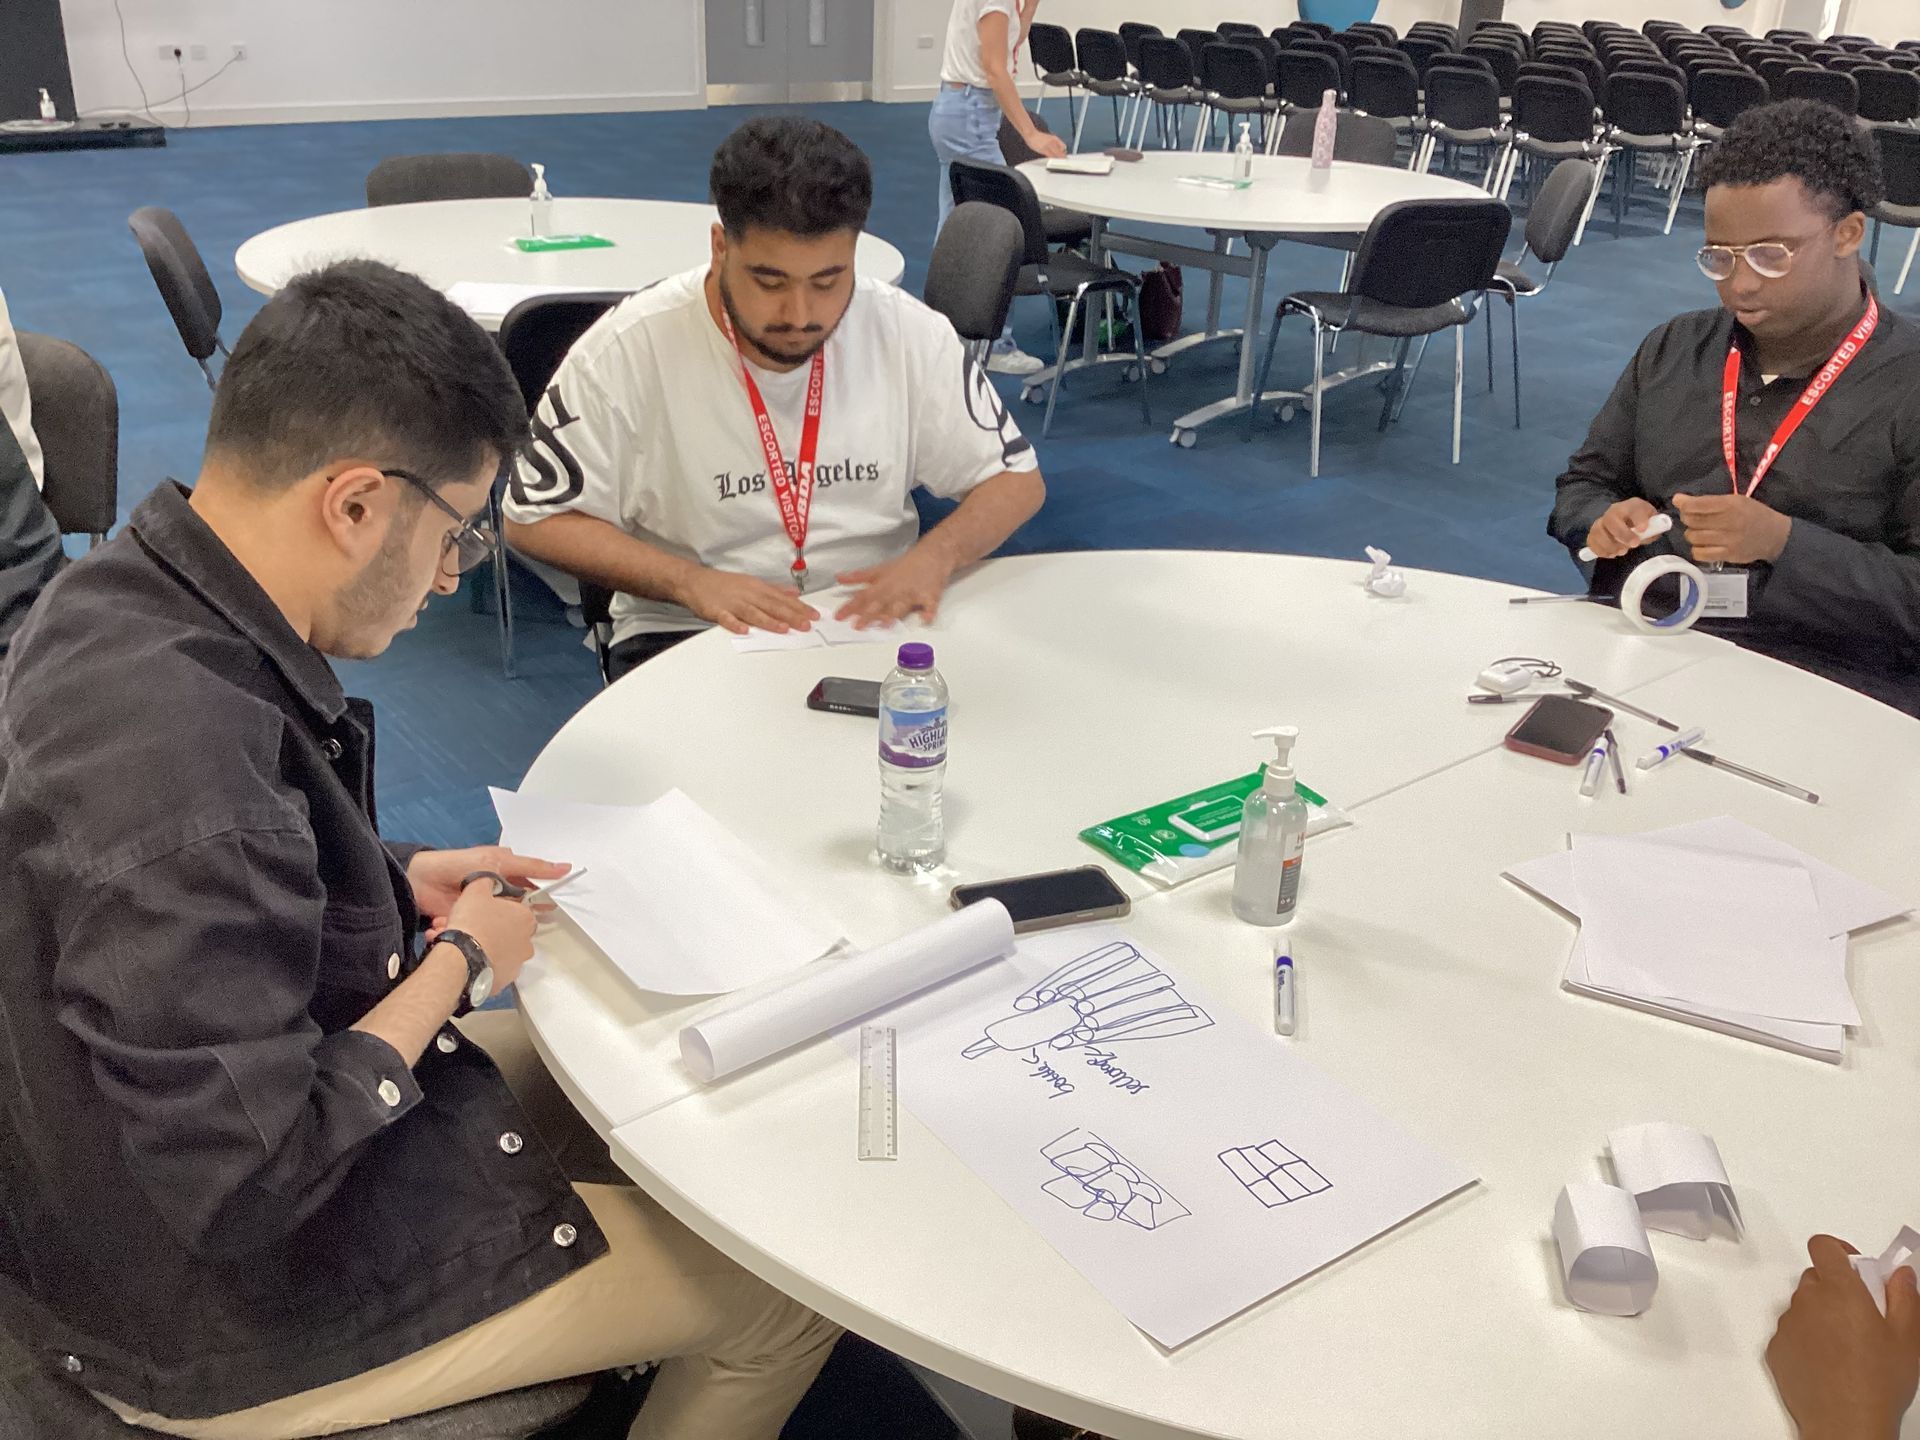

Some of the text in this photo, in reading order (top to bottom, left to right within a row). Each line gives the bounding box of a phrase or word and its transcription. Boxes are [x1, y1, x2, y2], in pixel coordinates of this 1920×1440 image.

[1801, 341, 1857, 406] ESCORTED
[758, 413, 786, 487] ESCORTED
[1722, 391, 1734, 460] ESCORTED
[713, 456, 880, 501] Los Ageles
